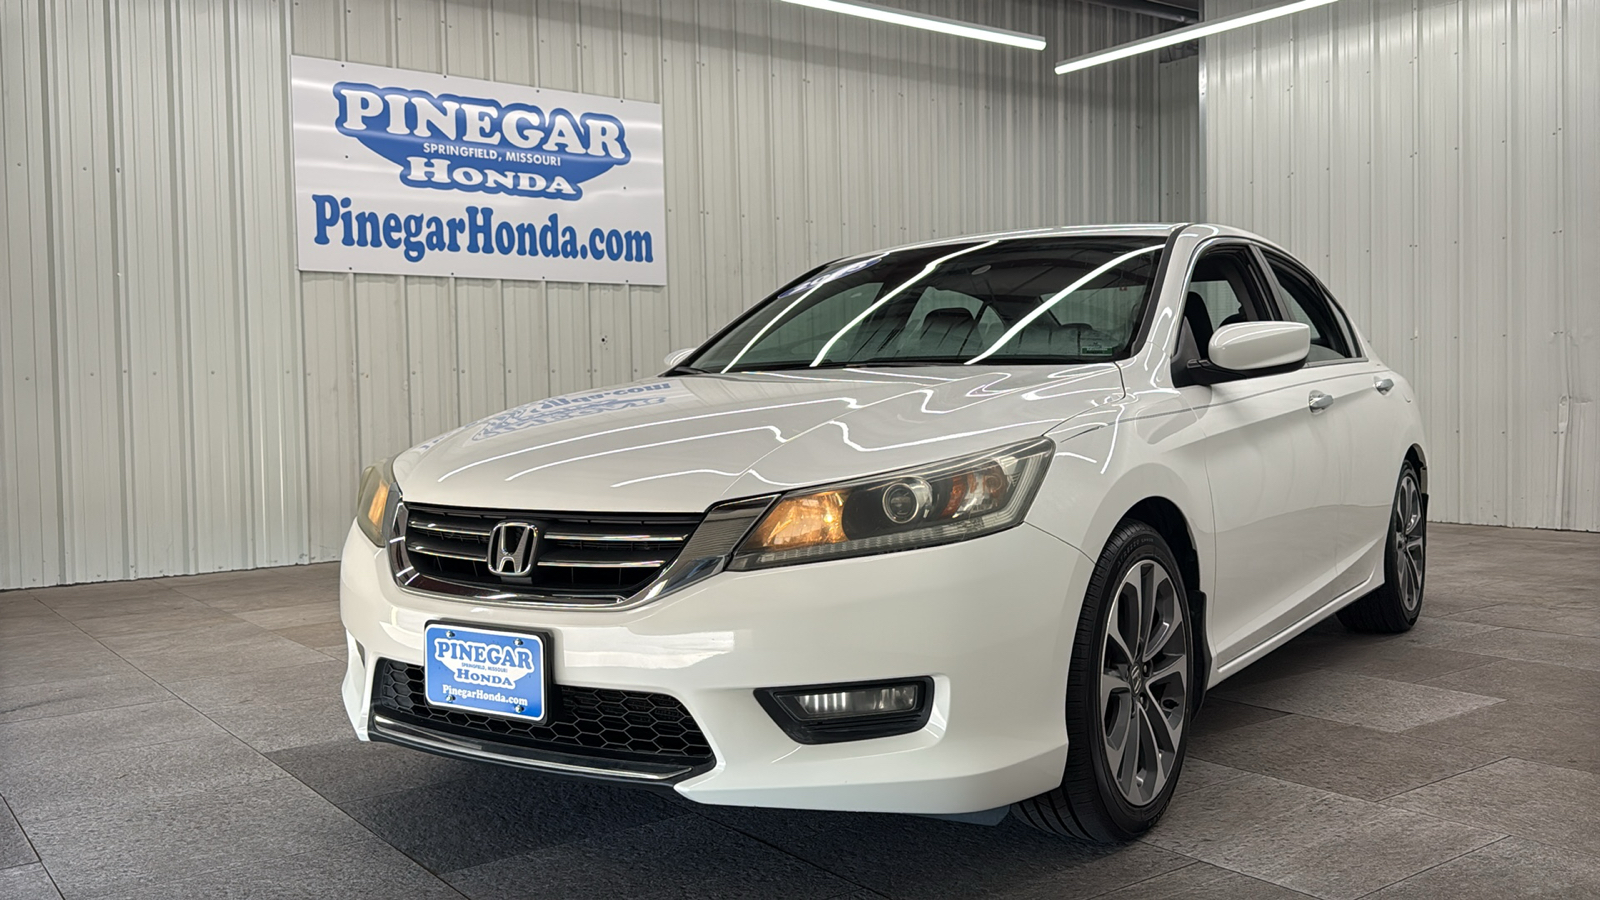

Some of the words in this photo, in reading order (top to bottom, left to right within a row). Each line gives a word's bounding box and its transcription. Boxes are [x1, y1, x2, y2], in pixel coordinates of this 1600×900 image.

[340, 89, 625, 160] PINEGAR
[423, 142, 502, 161] SPRINGFIELD,
[505, 151, 561, 166] MISSOURI
[406, 156, 577, 195] HONDA
[312, 194, 653, 263] PinegarHonda.com
[437, 641, 532, 670] PINEGAR
[456, 668, 513, 686] HONDA
[442, 684, 528, 706] PinegarHonda.com
